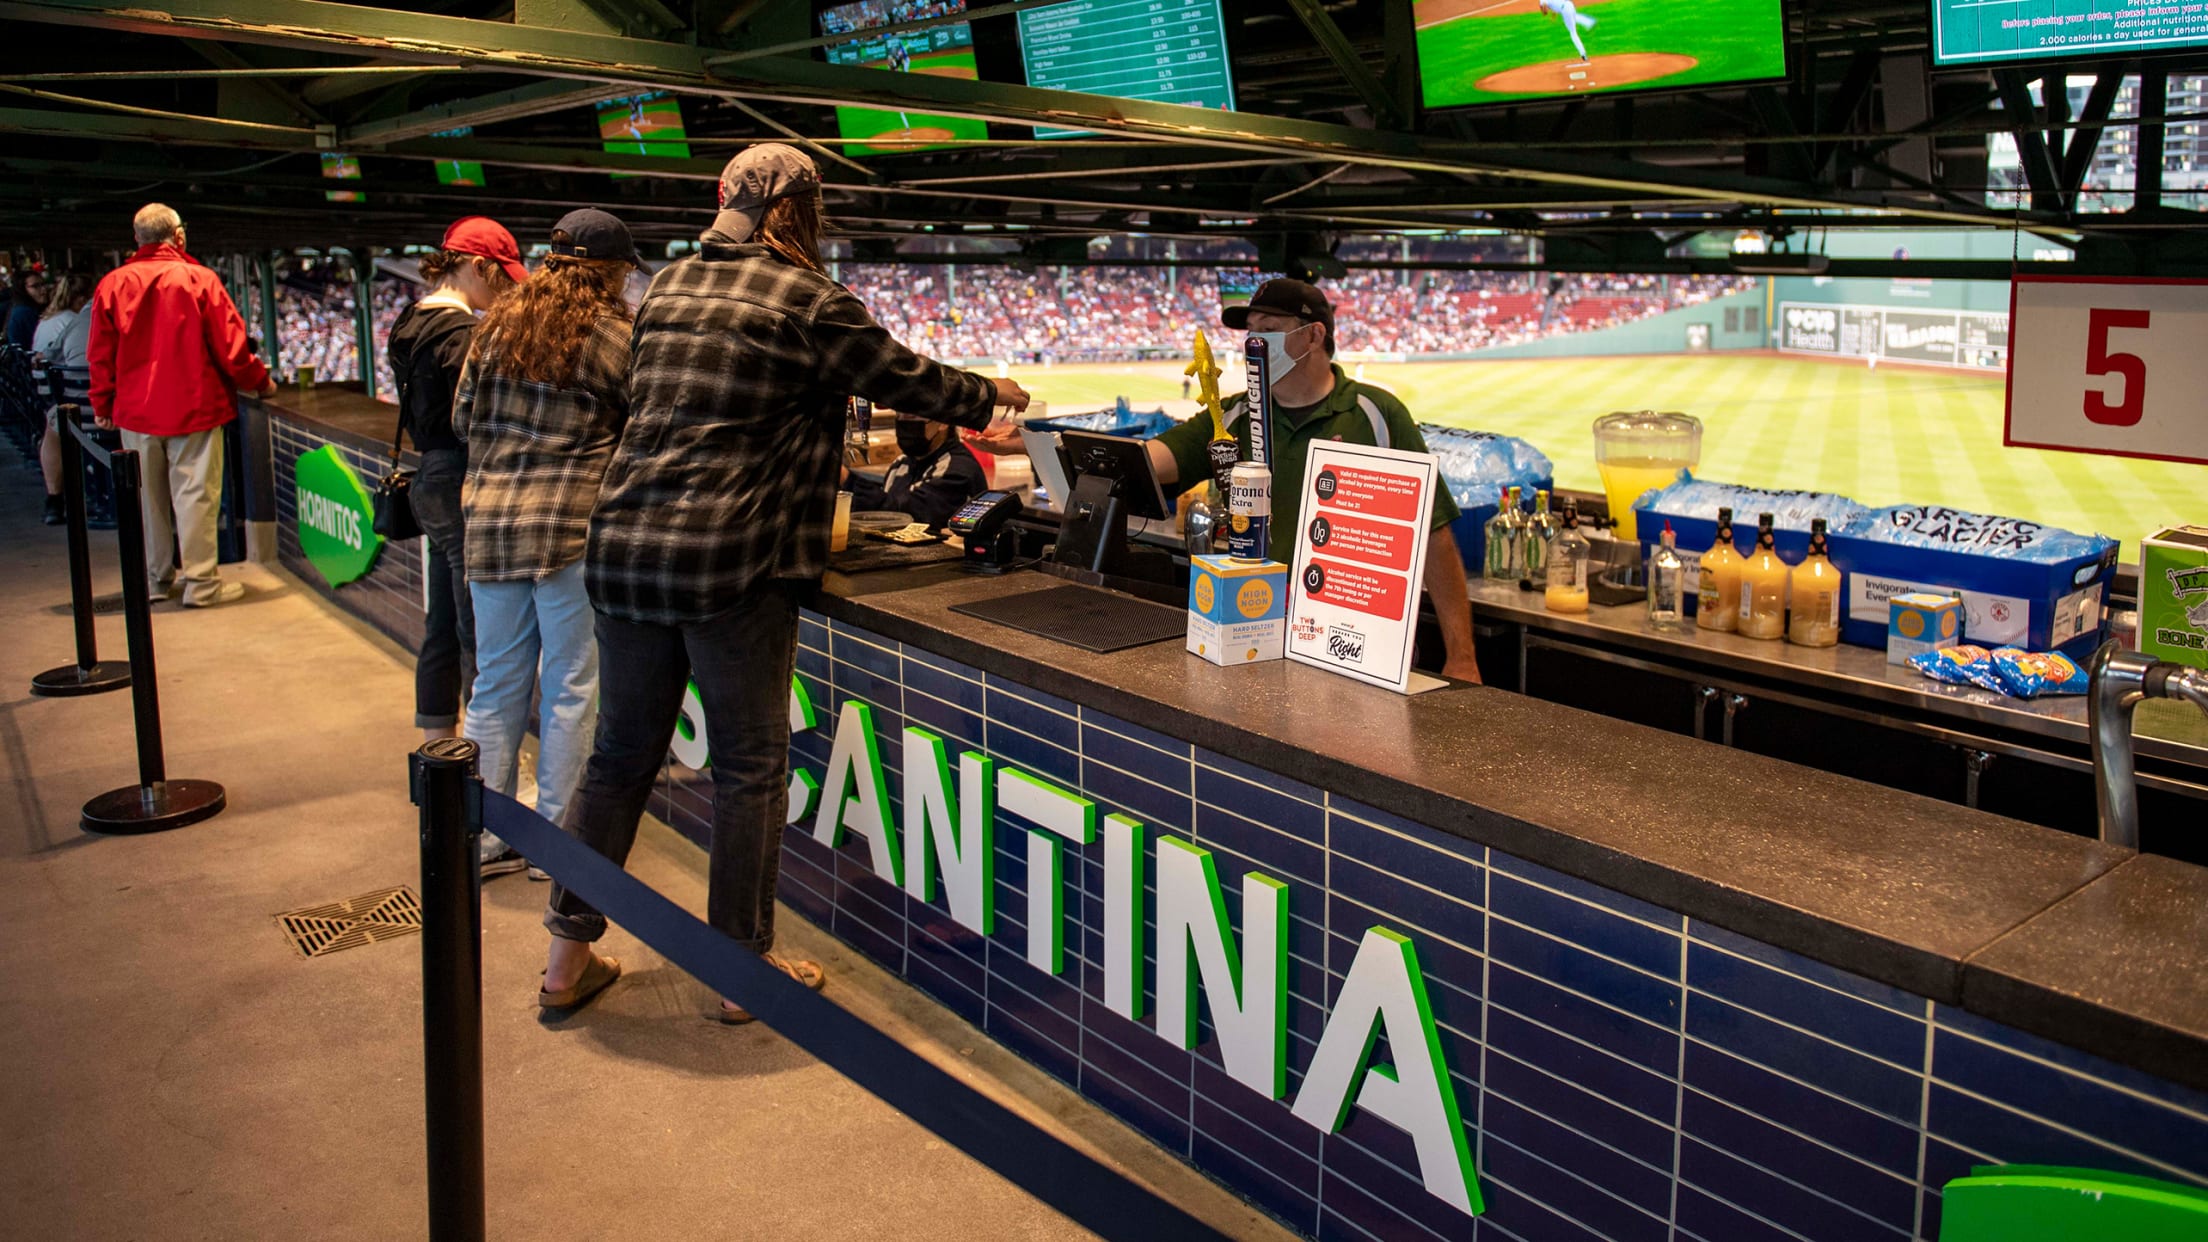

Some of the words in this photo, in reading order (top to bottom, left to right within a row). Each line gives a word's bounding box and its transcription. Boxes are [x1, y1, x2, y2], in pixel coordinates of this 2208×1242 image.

[2002, 19, 2030, 29] Before
[2031, 16, 2064, 27] placing
[2065, 13, 2085, 24] your
[2087, 11, 2112, 21] order,
[2115, 9, 2146, 21] please
[2148, 6, 2179, 17] inform
[2181, 3, 2203, 14] your
[2114, 18, 2160, 29] Additional
[2040, 36, 2066, 46] 2,000
[2068, 33, 2103, 43] calories
[2114, 31, 2130, 41] day
[2133, 29, 2155, 39] used
[2158, 28, 2171, 36] for
[1788, 329, 1834, 350] Health
[2084, 308, 2150, 427] 5
[1246, 362, 1262, 420] LIGHT
[1250, 422, 1265, 462] BUD
[1339, 478, 1356, 486] alcohol
[1363, 482, 1387, 492] everyone,
[1387, 486, 1401, 494] every
[1401, 487, 1414, 495] time
[1358, 474, 1379, 482] required
[1387, 478, 1410, 487] purchase
[1232, 496, 1253, 508] Extra
[1352, 492, 1374, 500] everyone
[298, 486, 362, 550] HORNITOS
[1332, 524, 1350, 533] Service
[1370, 531, 1379, 539] this
[1379, 534, 1394, 542] event
[1339, 542, 1356, 550] person
[1365, 547, 1393, 557] transaction
[1341, 535, 1361, 543] alcoholic
[1361, 538, 1387, 549] beverages
[1328, 567, 1345, 577] Alcohol
[1345, 572, 1362, 581] service
[1362, 575, 1372, 583] will
[1326, 576, 1356, 588] discontinued
[1362, 583, 1370, 591] the
[1243, 589, 1268, 599] HIGH
[1324, 591, 1345, 601] manager
[1345, 595, 1369, 606] discretion
[1342, 587, 1357, 597] inning
[1241, 598, 1269, 608] NOON
[1251, 623, 1275, 632] SELTZER
[1301, 617, 1315, 625] TWO
[1292, 624, 1324, 635] BUTTONS
[1299, 633, 1316, 641] DEEP
[2158, 629, 2204, 649] BONE
[1329, 635, 1362, 660] Right
